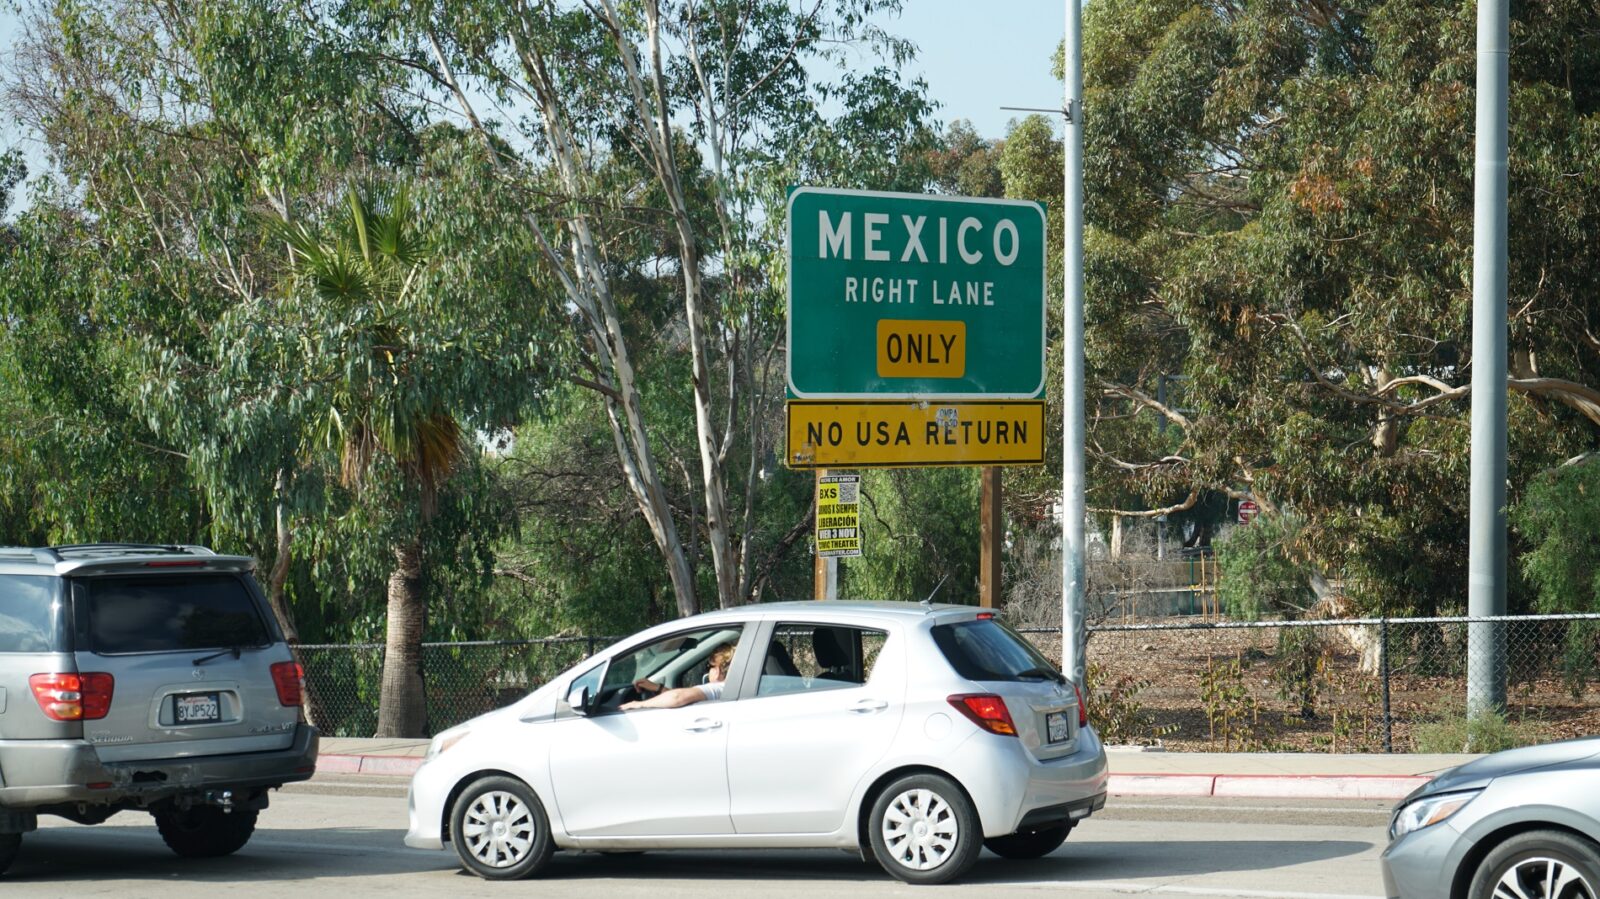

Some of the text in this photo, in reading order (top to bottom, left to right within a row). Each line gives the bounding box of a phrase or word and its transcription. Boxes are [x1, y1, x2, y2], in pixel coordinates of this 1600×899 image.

[818, 210, 1019, 266] MEXICO
[845, 277, 995, 306] RIGHT LANE
[887, 333, 957, 364] ONLY
[807, 420, 1027, 447] NO USA RETURN
[819, 488, 837, 499] BXS
[835, 503, 858, 513] SIEMPRE
[818, 514, 856, 528] LIBERACIÓN
[832, 529, 837, 538] 3
[838, 528, 855, 538] NOV
[831, 540, 858, 548] THEATRE
[178, 704, 217, 718] 8YJP522
